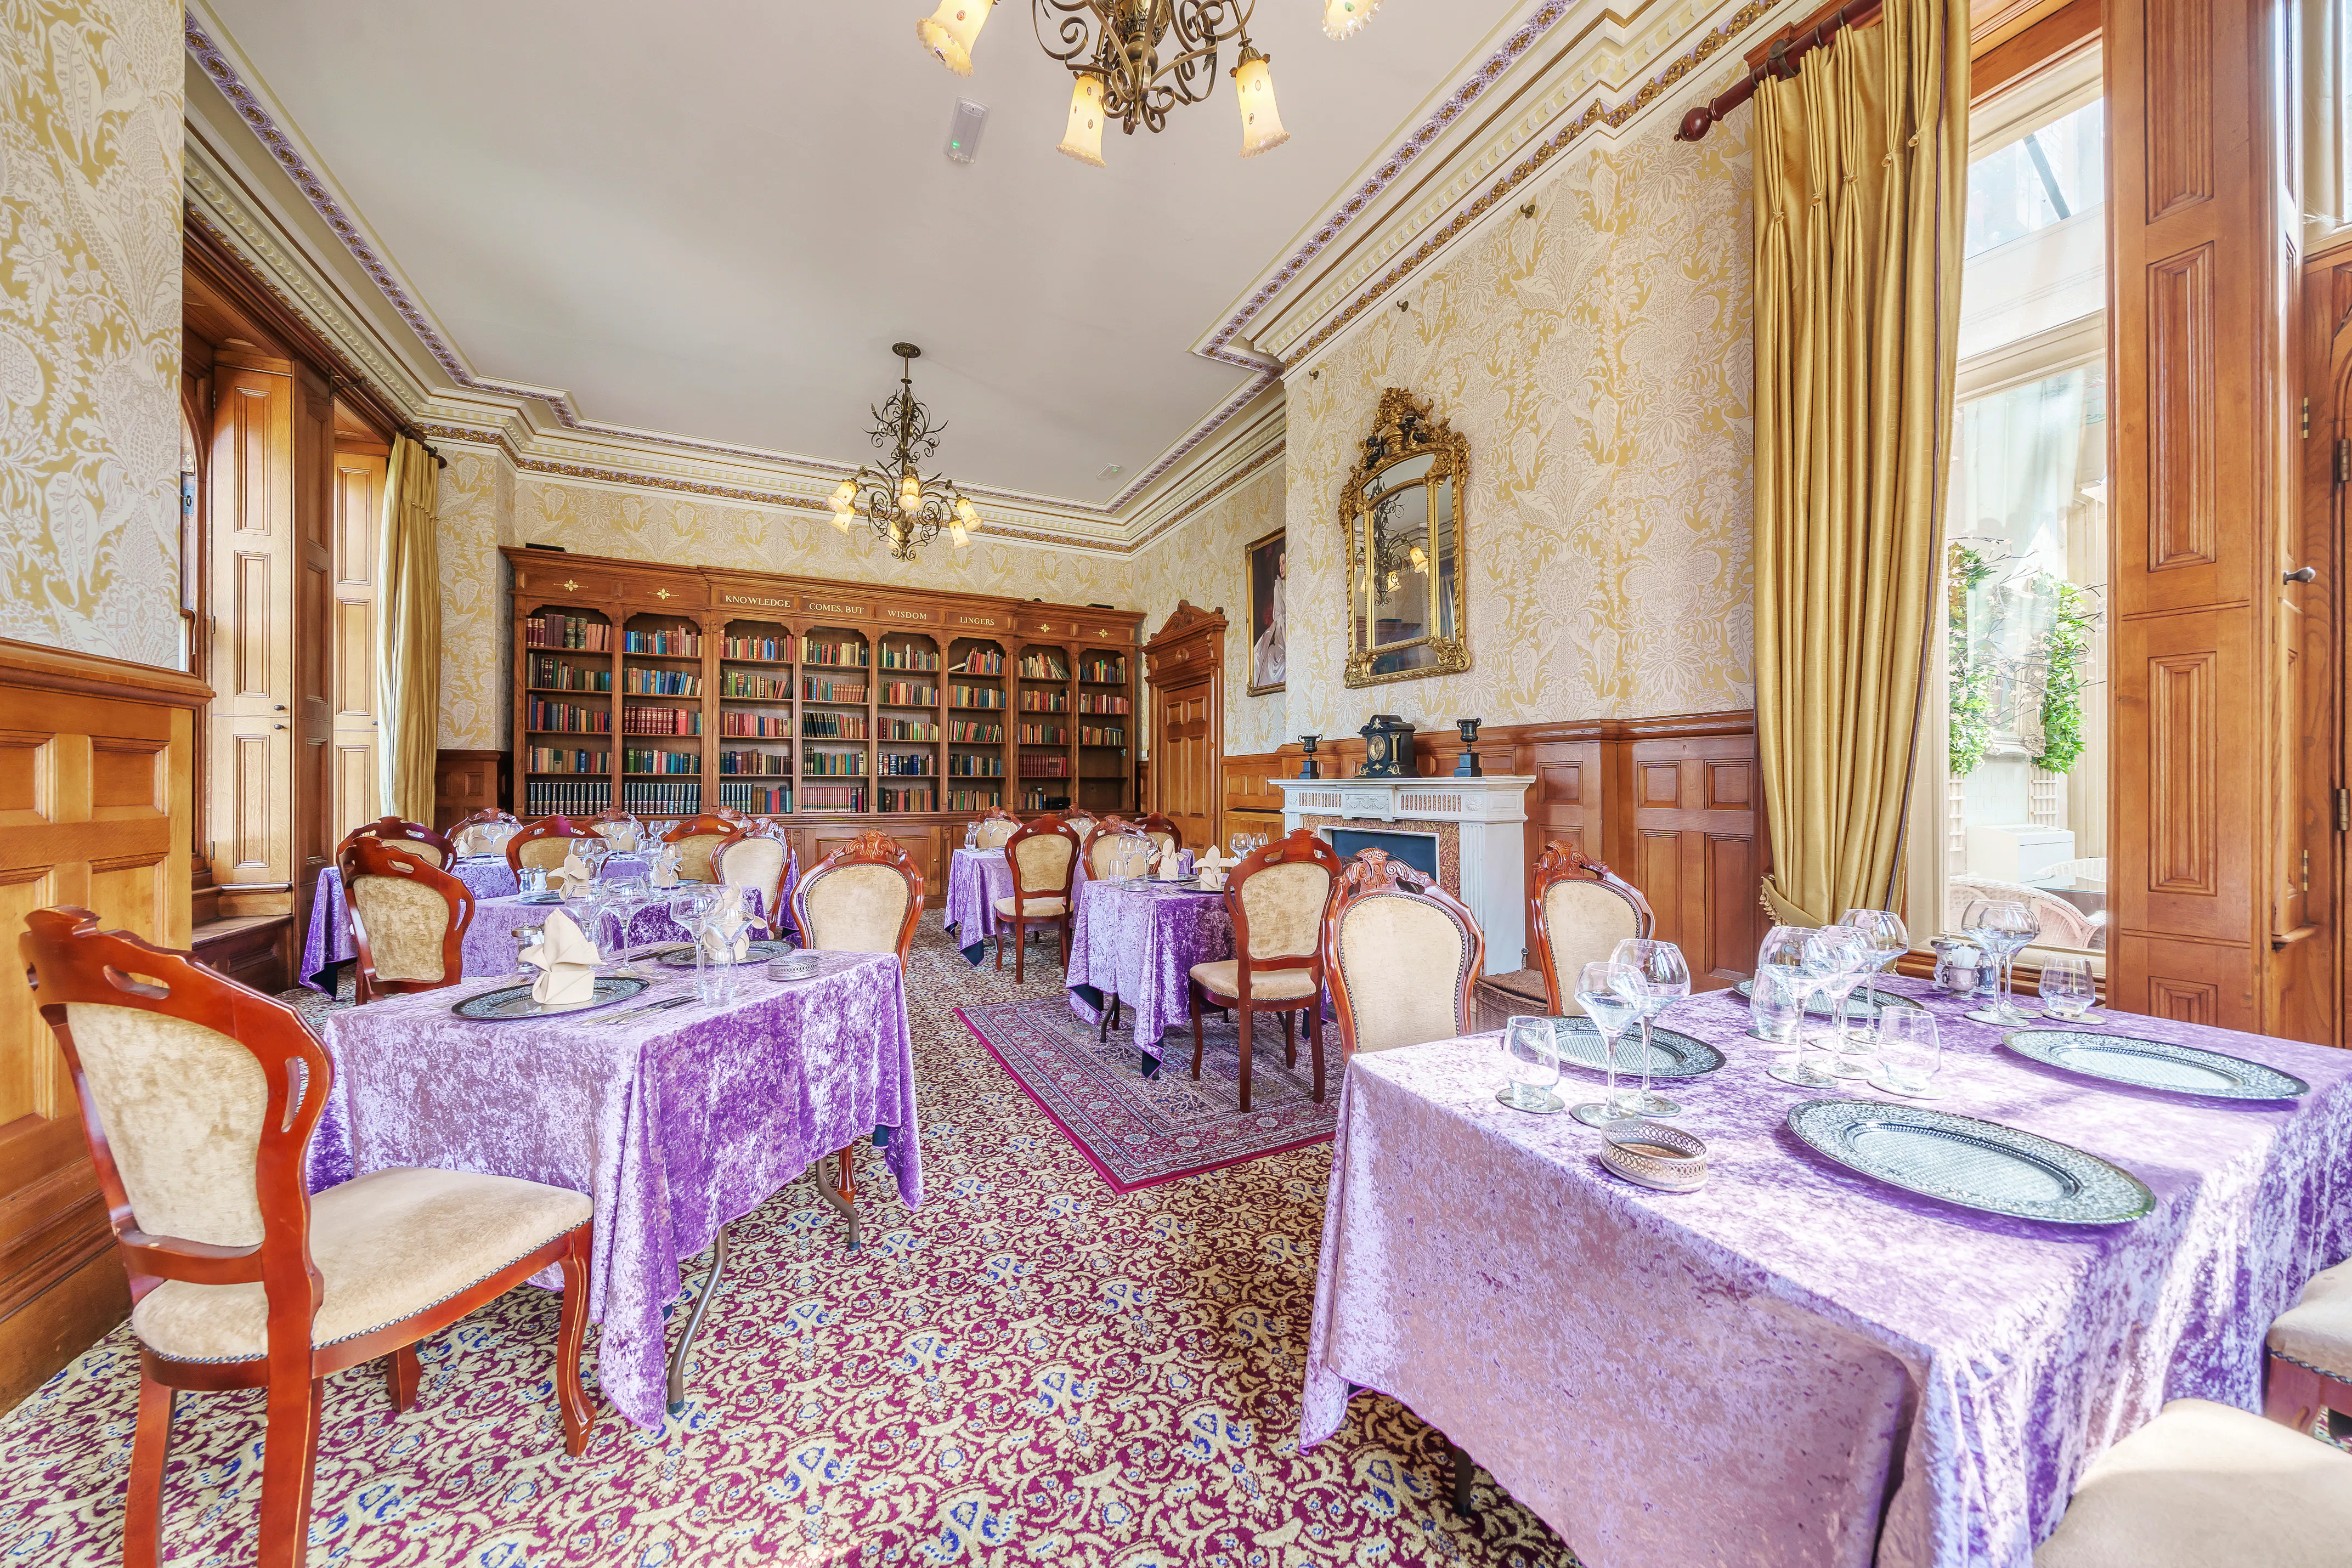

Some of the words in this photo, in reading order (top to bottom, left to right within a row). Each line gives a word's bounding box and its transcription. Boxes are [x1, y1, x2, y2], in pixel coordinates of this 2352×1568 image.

[726, 595, 790, 608] KNOWLEDGE
[808, 603, 843, 613] COMES,
[845, 605, 864, 614] BUT
[887, 610, 926, 620] WISDOM
[960, 616, 994, 625] LINGERS
